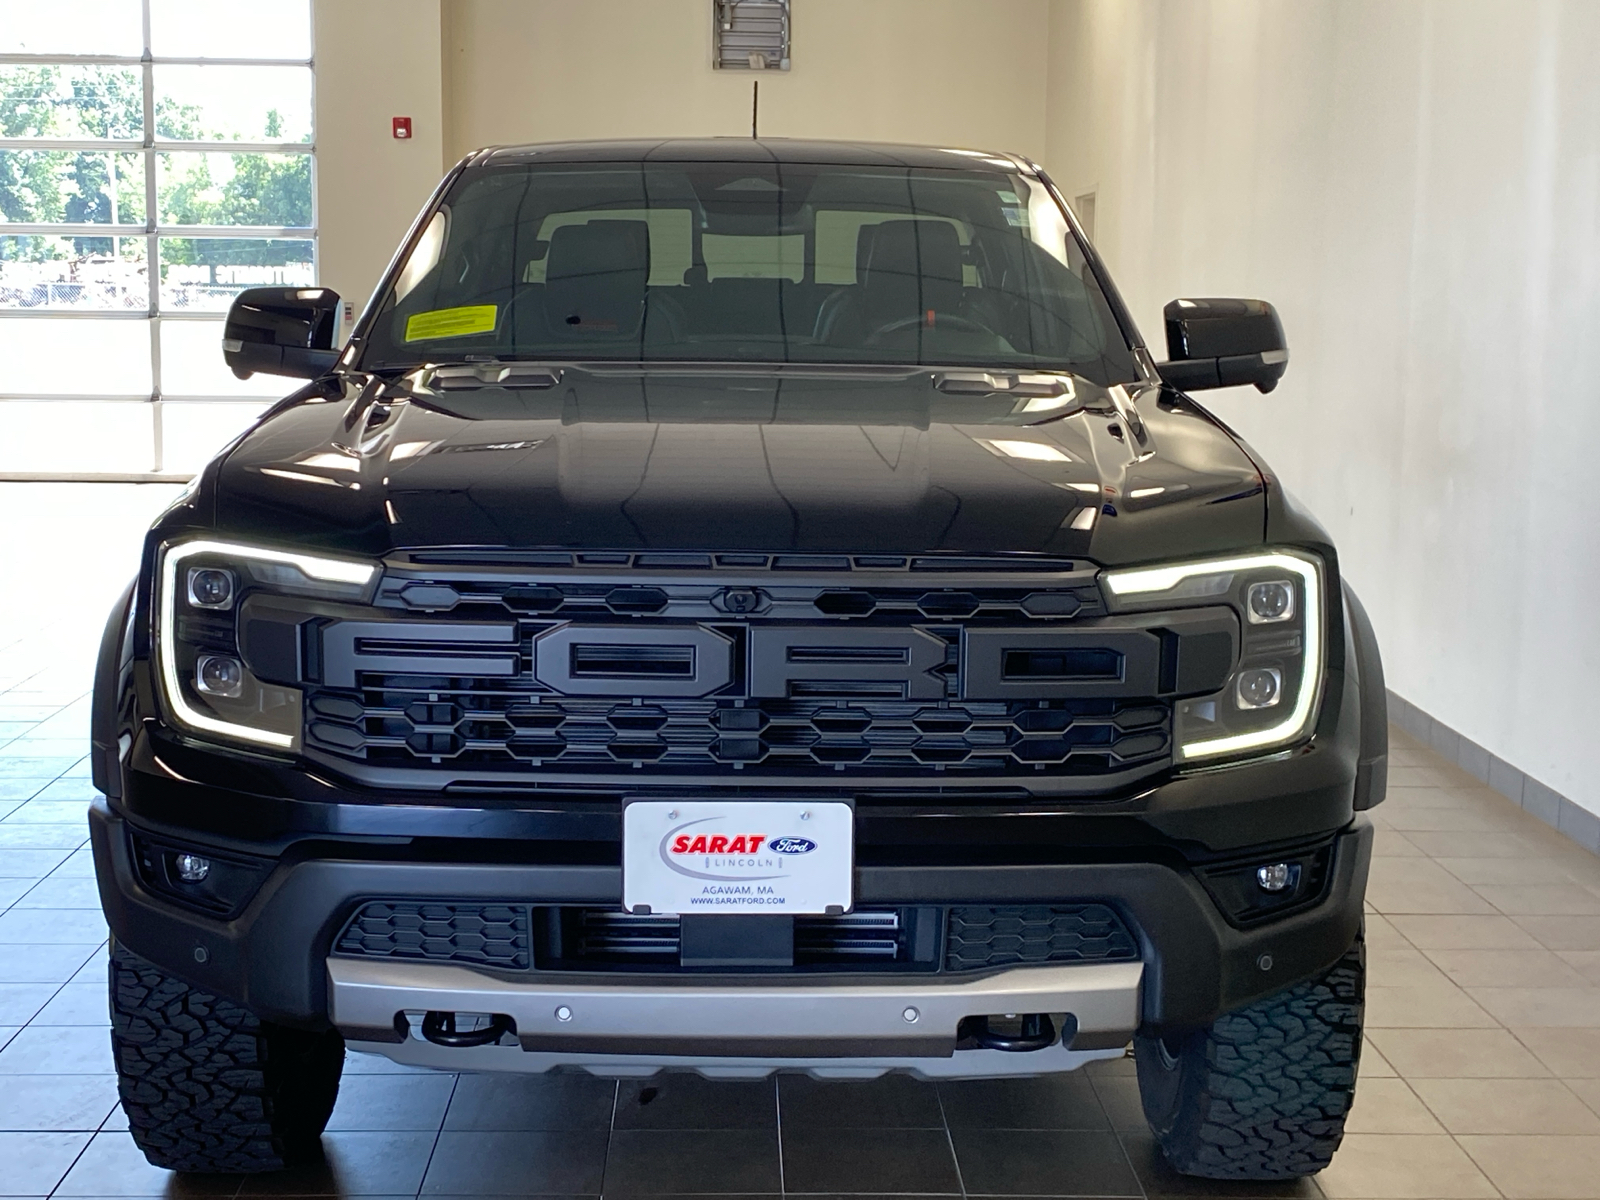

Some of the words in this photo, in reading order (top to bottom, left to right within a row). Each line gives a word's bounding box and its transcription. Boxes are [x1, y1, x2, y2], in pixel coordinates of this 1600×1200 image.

[321, 619, 1161, 702] FORD
[671, 834, 766, 854] SARAT
[775, 837, 810, 853] Ford
[715, 859, 773, 867] LINCOLN
[702, 886, 754, 895] AGAWAM,
[757, 886, 774, 895] MA
[691, 897, 786, 905] WWW.SARATFORD.COM
